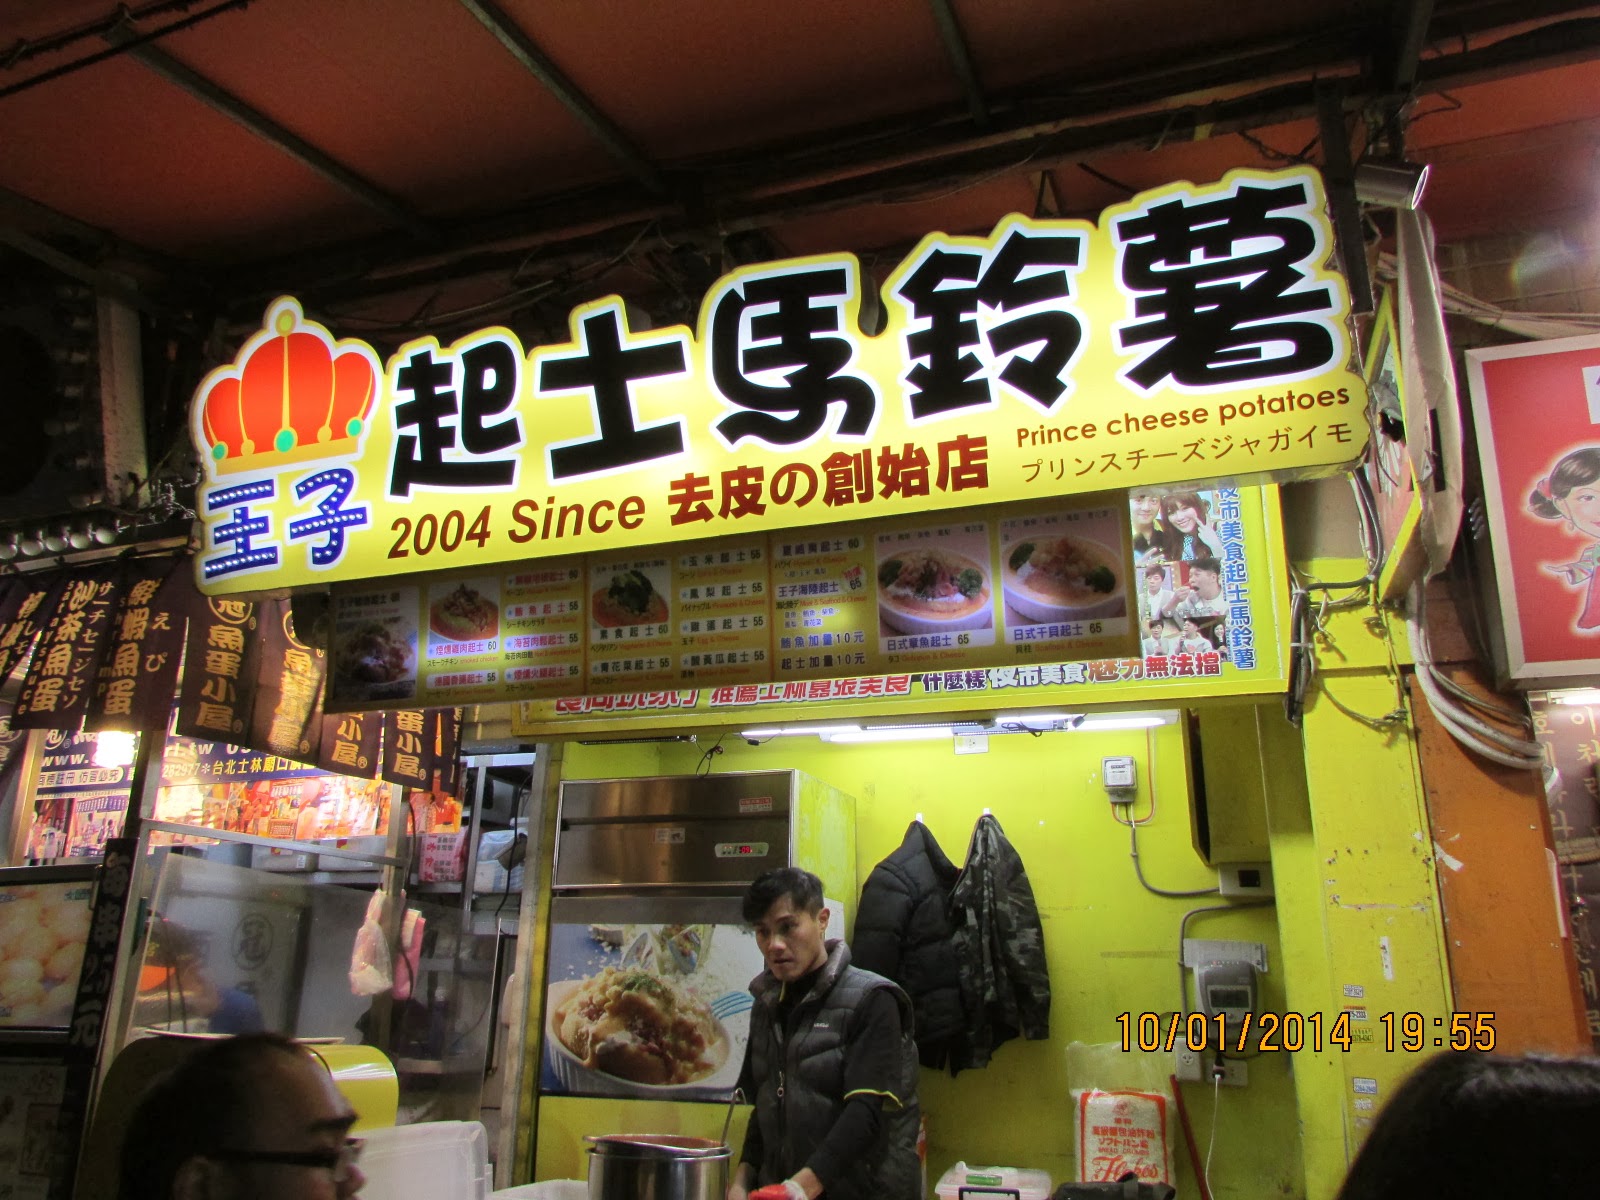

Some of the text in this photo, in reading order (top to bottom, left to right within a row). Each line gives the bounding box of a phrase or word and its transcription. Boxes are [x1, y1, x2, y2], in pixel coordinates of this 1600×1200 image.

[390, 185, 1335, 498] 起士馬鈴薯
[1016, 384, 1350, 448] Prince cheese potatoes
[1021, 423, 1352, 484] プリンスチーズジャガイモ
[387, 434, 989, 560] 2004 Since 去皮の創始店
[205, 468, 367, 580] 王子
[850, 578, 862, 590] 65
[753, 616, 763, 626] 55
[1089, 622, 1102, 634] 65
[569, 633, 578, 643] 55
[958, 633, 969, 644] 65
[488, 640, 497, 650] 60
[754, 650, 764, 660] 55
[660, 658, 670, 668] 55
[195, 625, 244, 732] 魚蛋小屋
[487, 672, 496, 682] 55
